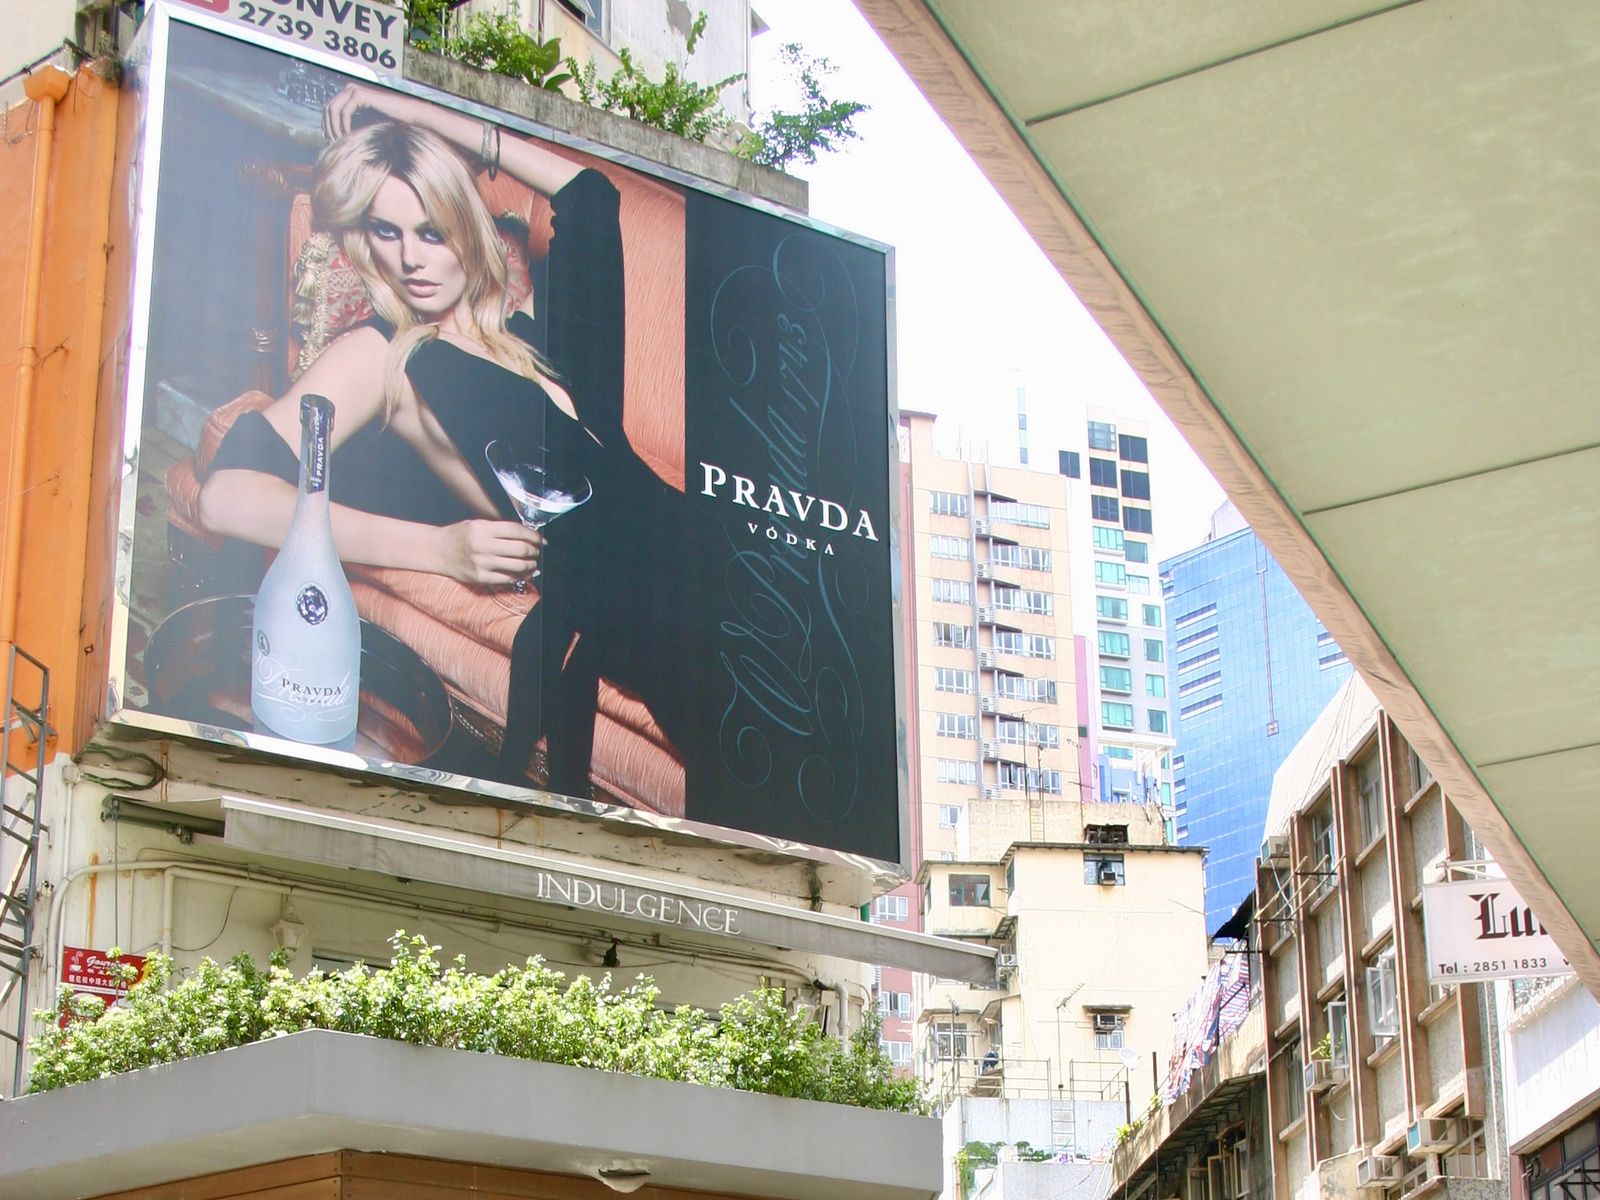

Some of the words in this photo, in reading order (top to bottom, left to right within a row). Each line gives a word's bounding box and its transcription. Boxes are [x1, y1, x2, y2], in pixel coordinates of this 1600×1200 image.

[238, 1, 314, 41] 2739
[323, 29, 397, 70] 3806
[271, 0, 398, 40] NVEY
[316, 437, 325, 477] PRAVDA
[700, 461, 880, 542] PRAVDA
[747, 522, 835, 556] VÓDKA
[281, 677, 342, 697] PRAVDA
[536, 872, 743, 935] INDULGENCE
[1468, 893, 1549, 940] Lu
[1439, 963, 1458, 975] Tel
[1473, 960, 1507, 973] 2851
[1513, 958, 1548, 970] 1833
